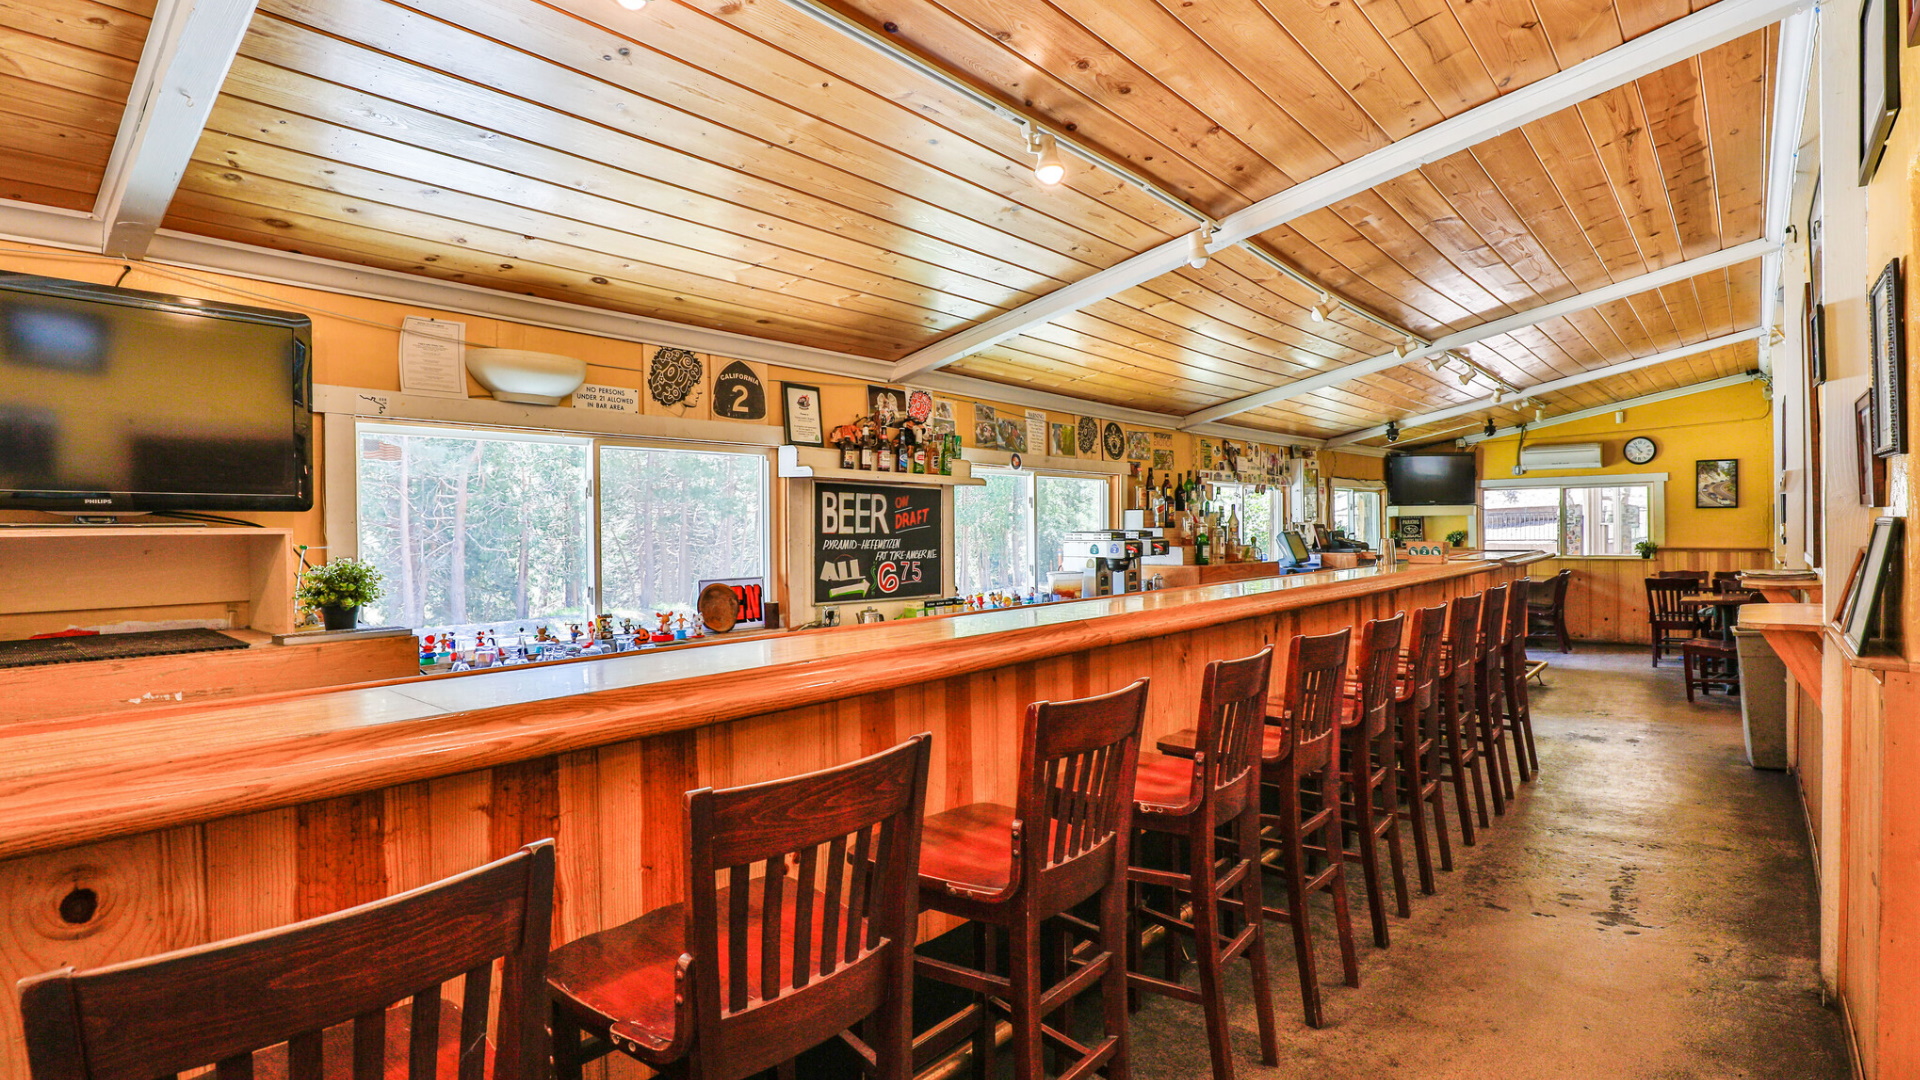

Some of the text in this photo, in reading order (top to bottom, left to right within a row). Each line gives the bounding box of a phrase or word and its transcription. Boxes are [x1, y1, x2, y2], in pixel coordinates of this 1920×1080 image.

[720, 373, 759, 386] CALIFORNIA
[598, 388, 625, 396] PERSONS
[732, 385, 749, 413] 2
[822, 491, 890, 534] BEER
[895, 508, 930, 529] DRAFT
[875, 551, 888, 561] FAT
